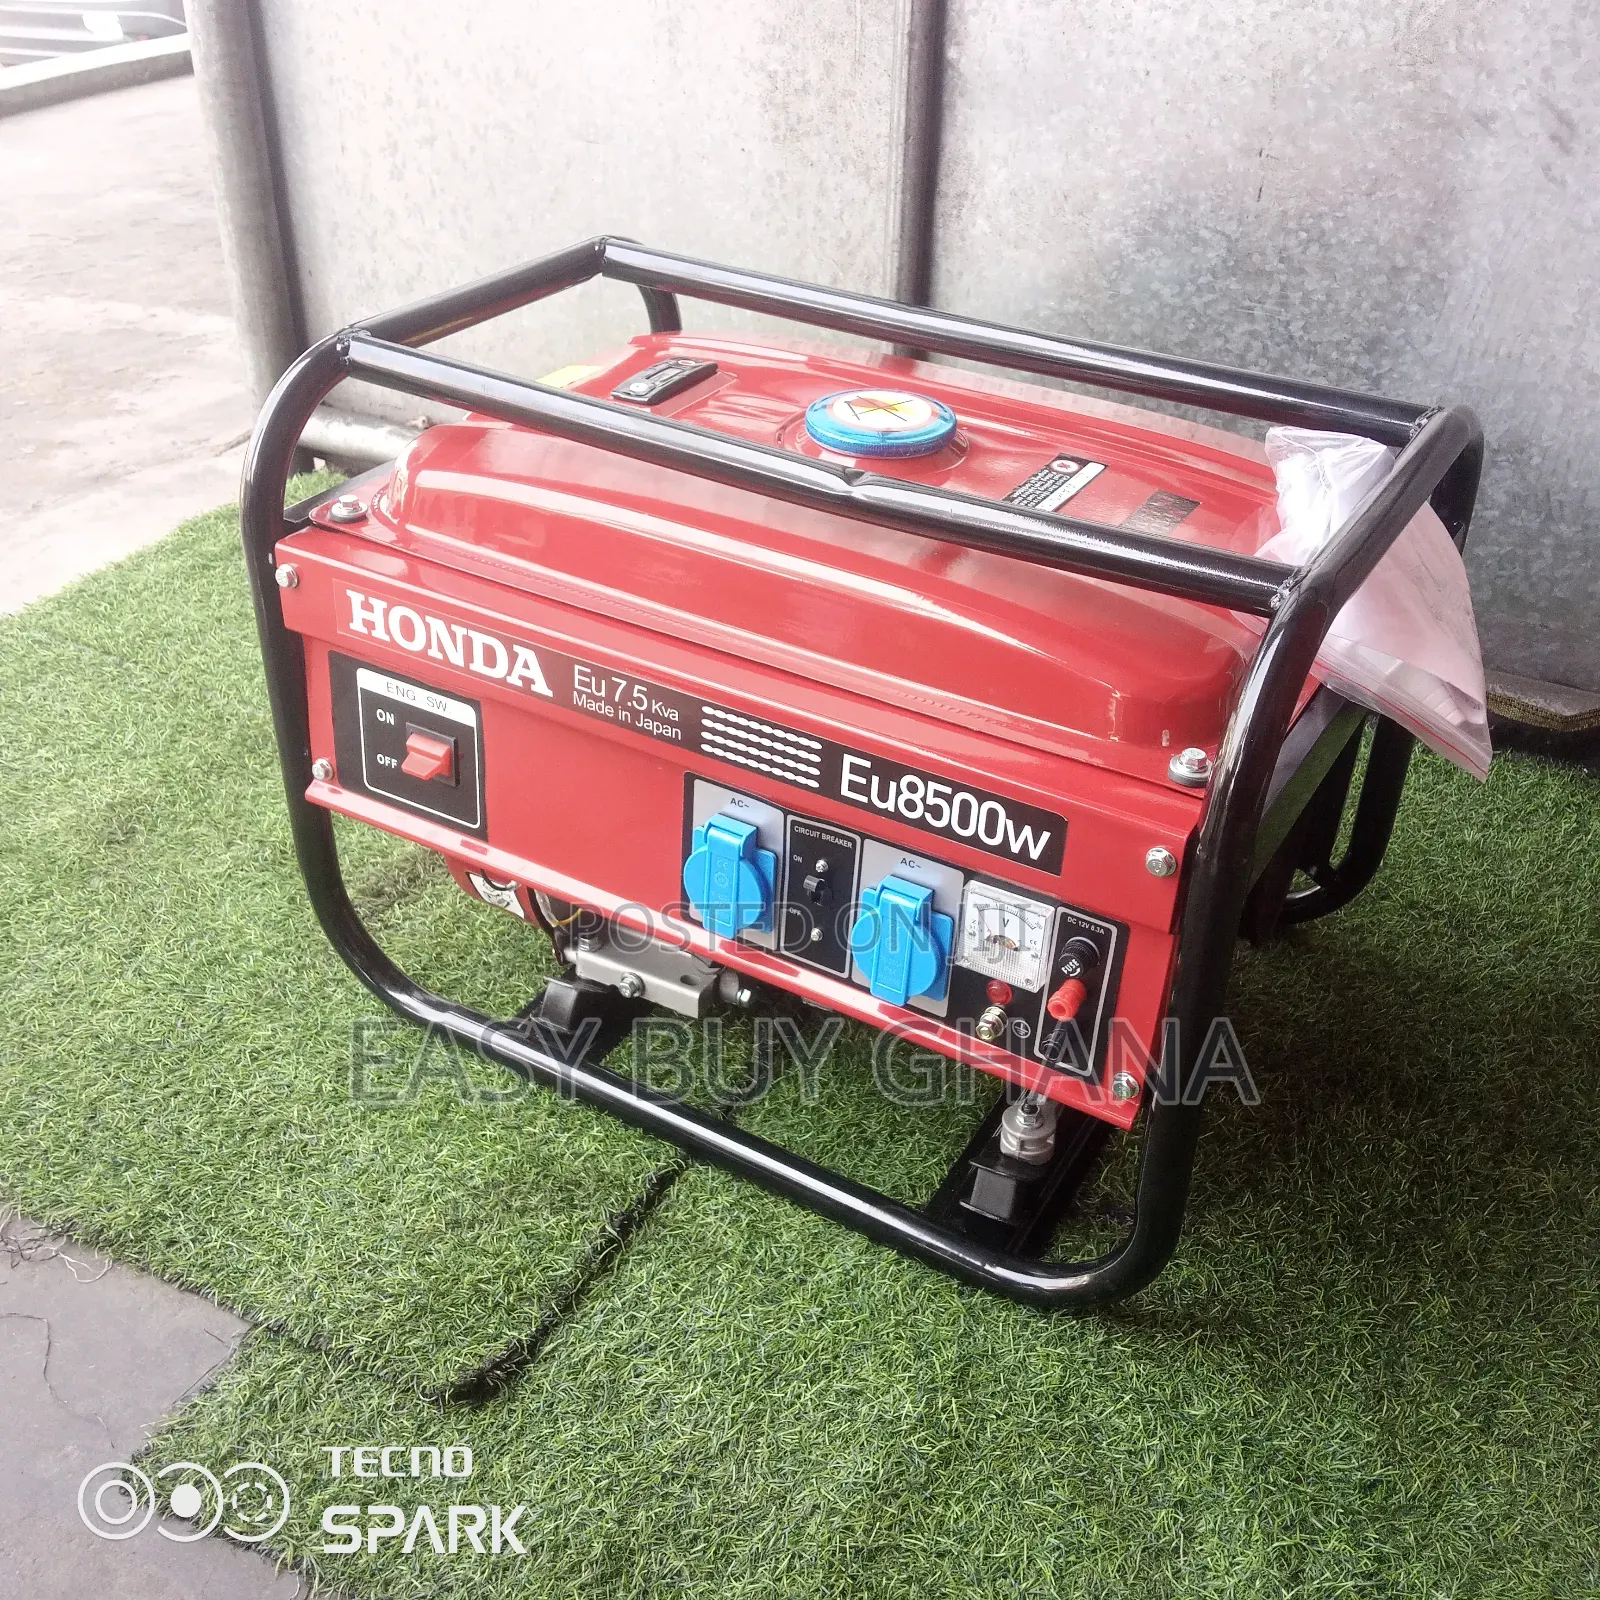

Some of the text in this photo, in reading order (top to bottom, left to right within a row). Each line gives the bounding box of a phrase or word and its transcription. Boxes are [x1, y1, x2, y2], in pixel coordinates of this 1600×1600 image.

[346, 589, 553, 697] HONDA
[386, 681, 416, 700] ENG
[574, 664, 679, 721] Eu 7.5 Kva
[376, 708, 395, 725] ON
[573, 690, 682, 740] Made in Japan
[377, 753, 398, 768] OFF
[840, 753, 1051, 861] Eu8500w
[794, 825, 853, 849] CIRCUIT BREAKER
[793, 854, 803, 863] ON
[1002, 917, 1010, 928] V
[1067, 916, 1077, 925] DC
[1078, 921, 1090, 929] 12V
[1061, 958, 1080, 975] FUSE
